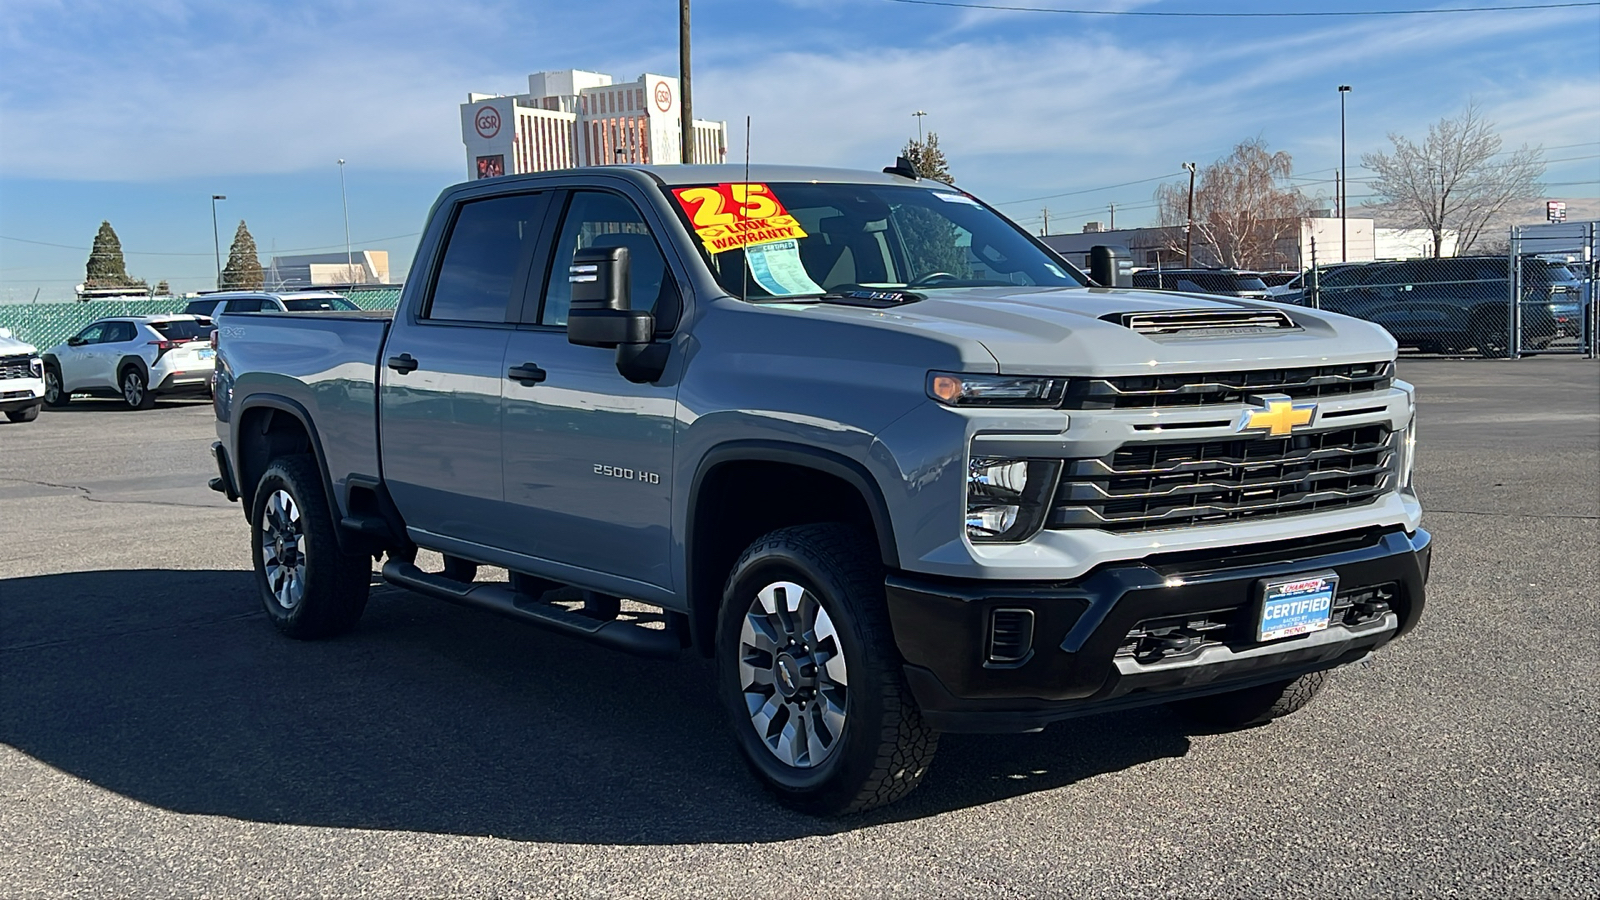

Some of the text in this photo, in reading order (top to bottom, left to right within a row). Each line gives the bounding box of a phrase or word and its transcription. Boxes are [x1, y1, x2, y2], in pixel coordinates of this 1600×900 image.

[478, 115, 498, 130] GSR
[679, 184, 782, 227] 25
[725, 218, 772, 235] LOOK
[711, 227, 795, 250] WARRANTY
[593, 463, 660, 485] 2500 HD
[1284, 580, 1320, 593] CHAMPION
[1263, 596, 1331, 620] CERTIFIED
[1283, 625, 1307, 636] RENO
